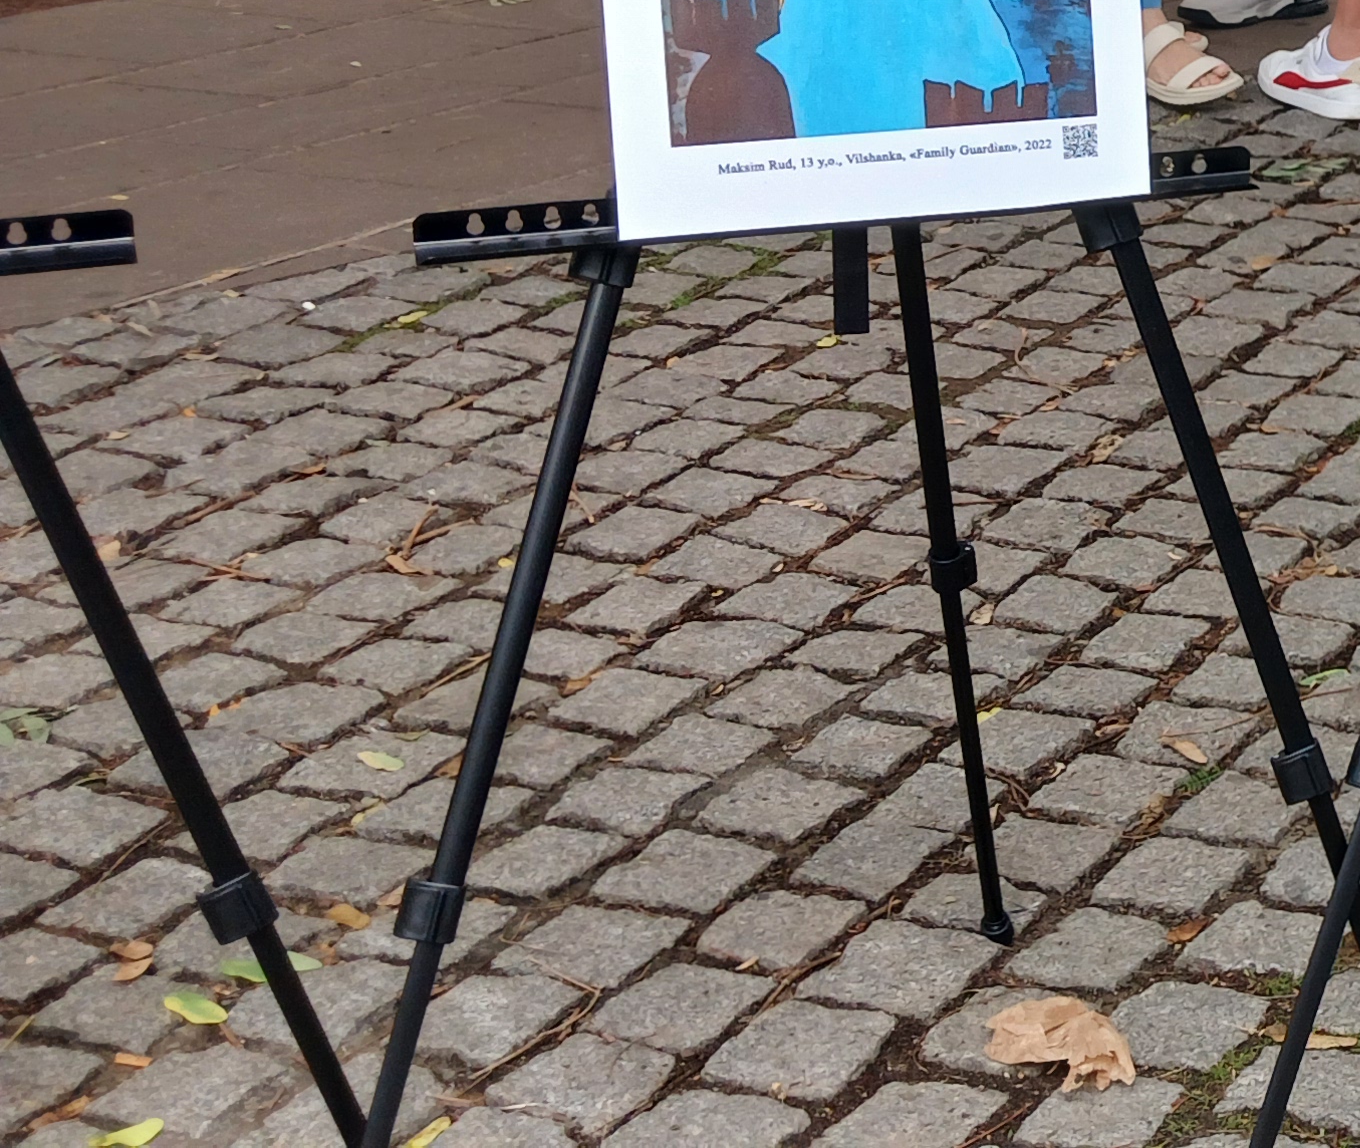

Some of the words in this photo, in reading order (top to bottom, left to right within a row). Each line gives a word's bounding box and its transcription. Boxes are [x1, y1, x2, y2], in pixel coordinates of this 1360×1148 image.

[718, 161, 765, 175] Maksim
[768, 158, 796, 171] Rud,
[800, 157, 814, 168] 13
[846, 150, 906, 164] Vilshanka,
[909, 144, 956, 160] «Family
[959, 140, 1022, 156] Guardian»,
[1024, 138, 1052, 151] 2022
